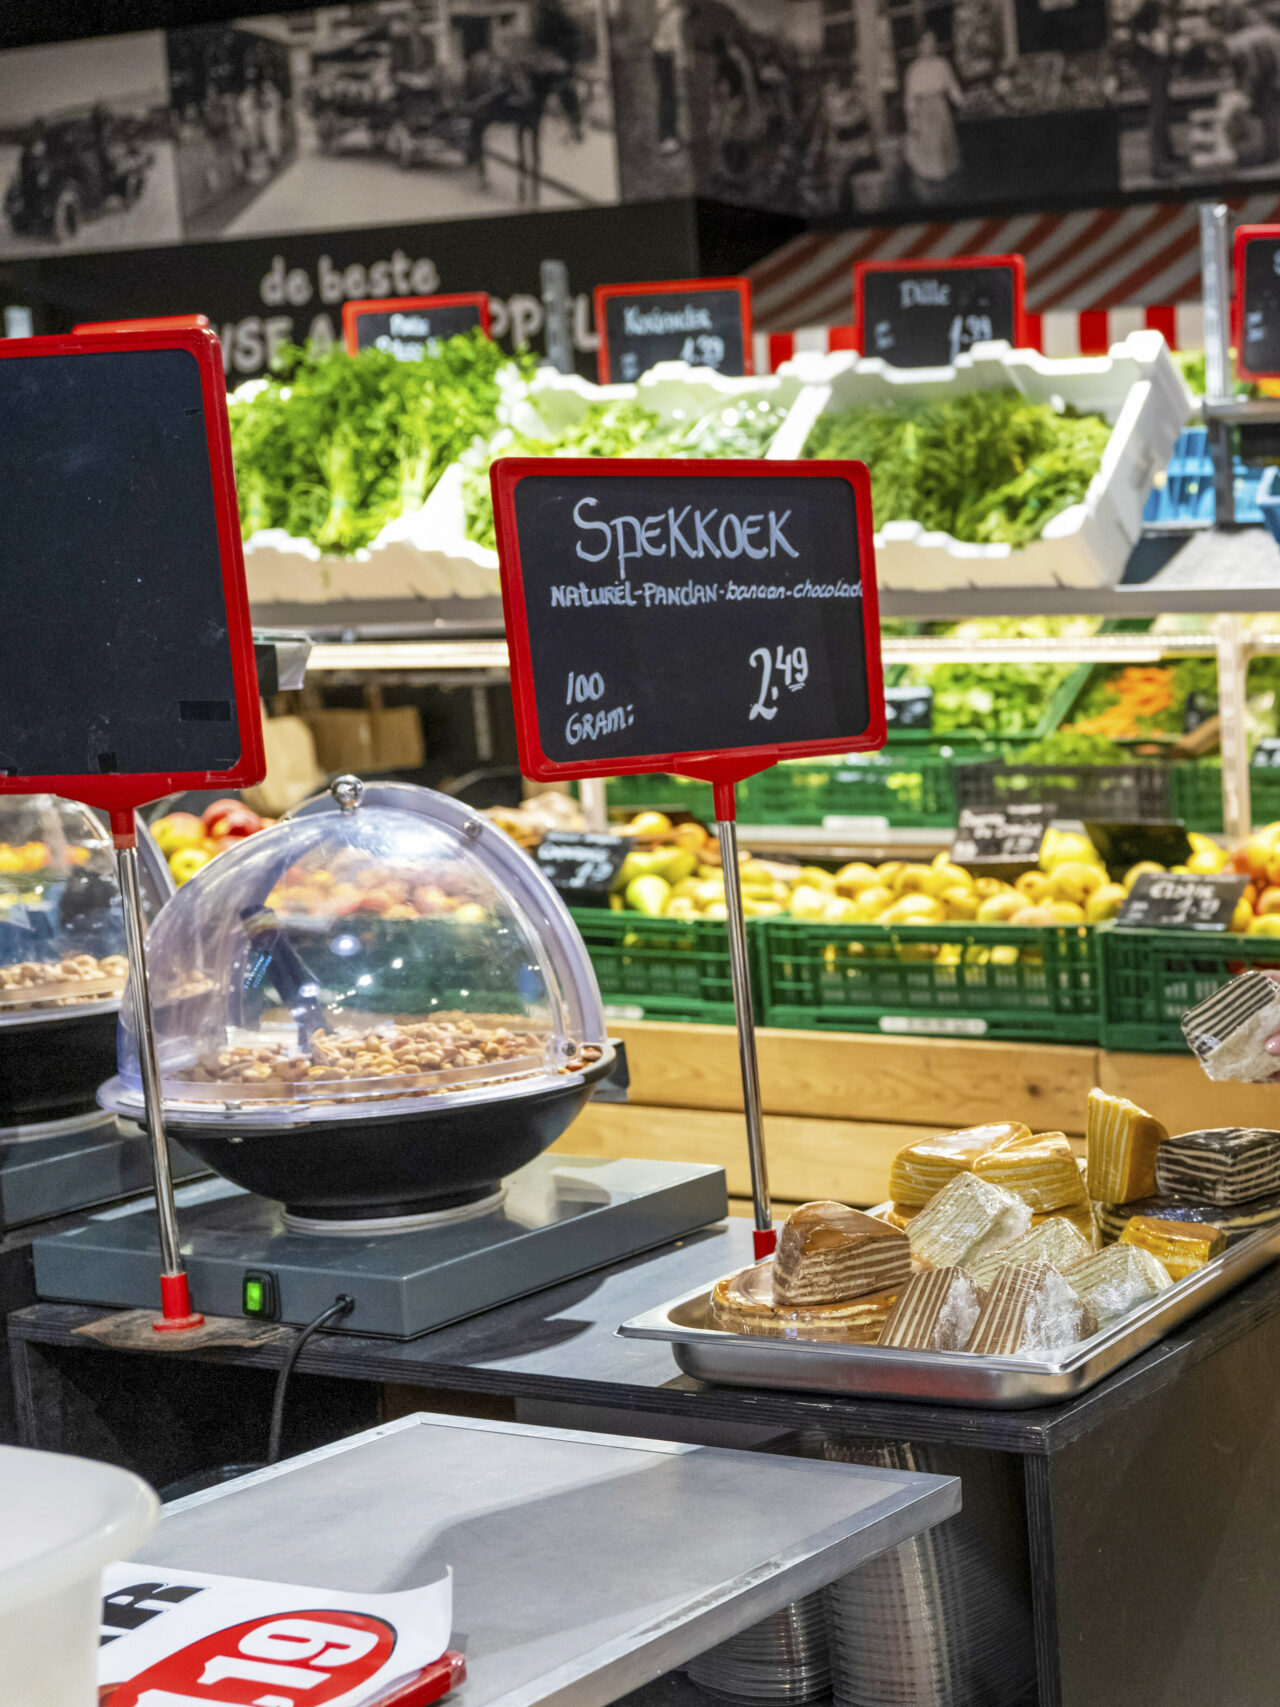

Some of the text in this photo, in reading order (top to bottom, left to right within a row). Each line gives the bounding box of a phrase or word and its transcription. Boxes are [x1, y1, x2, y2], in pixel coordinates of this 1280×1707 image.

[260, 249, 441, 305] de beste
[566, 671, 605, 705] 100
